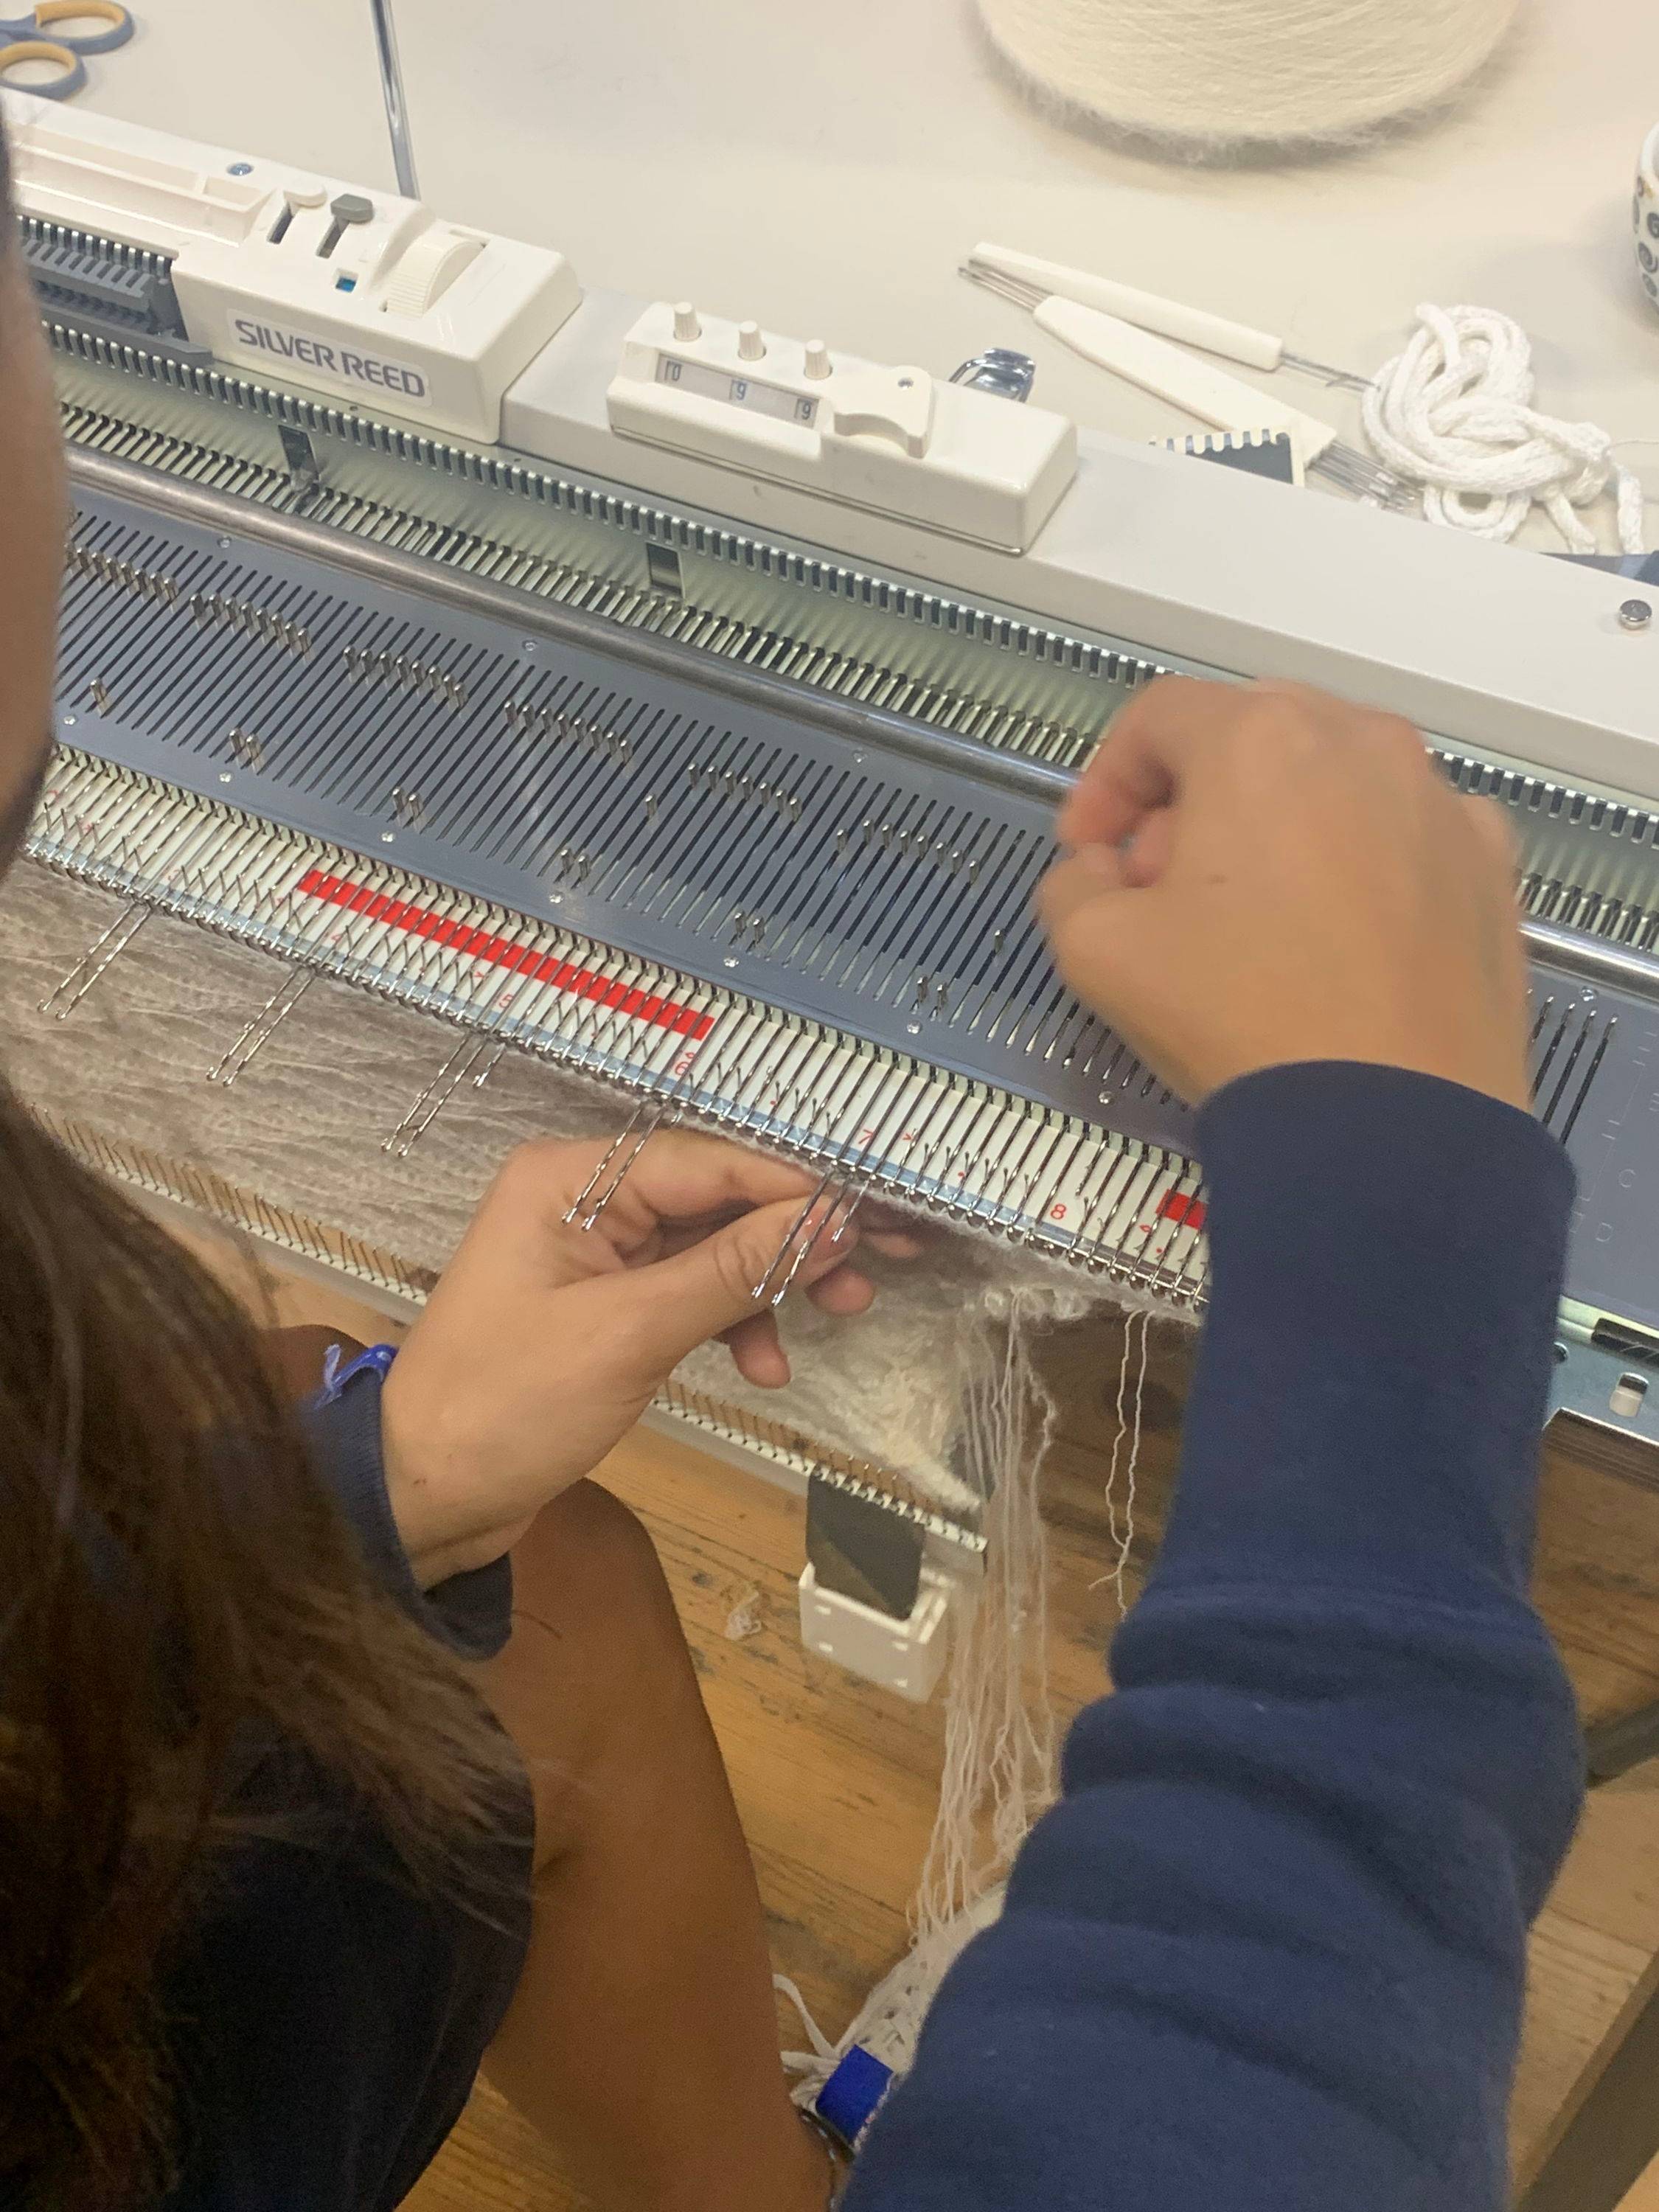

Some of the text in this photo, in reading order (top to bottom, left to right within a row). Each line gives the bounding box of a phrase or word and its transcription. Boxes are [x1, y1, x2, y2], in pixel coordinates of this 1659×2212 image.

[234, 319, 425, 398] SILVER REED
[801, 400, 812, 420] 9
[498, 993, 515, 1009] 5
[675, 1061, 691, 1076] 6
[858, 1128, 875, 1145] 7
[1050, 1203, 1067, 1220] 8
